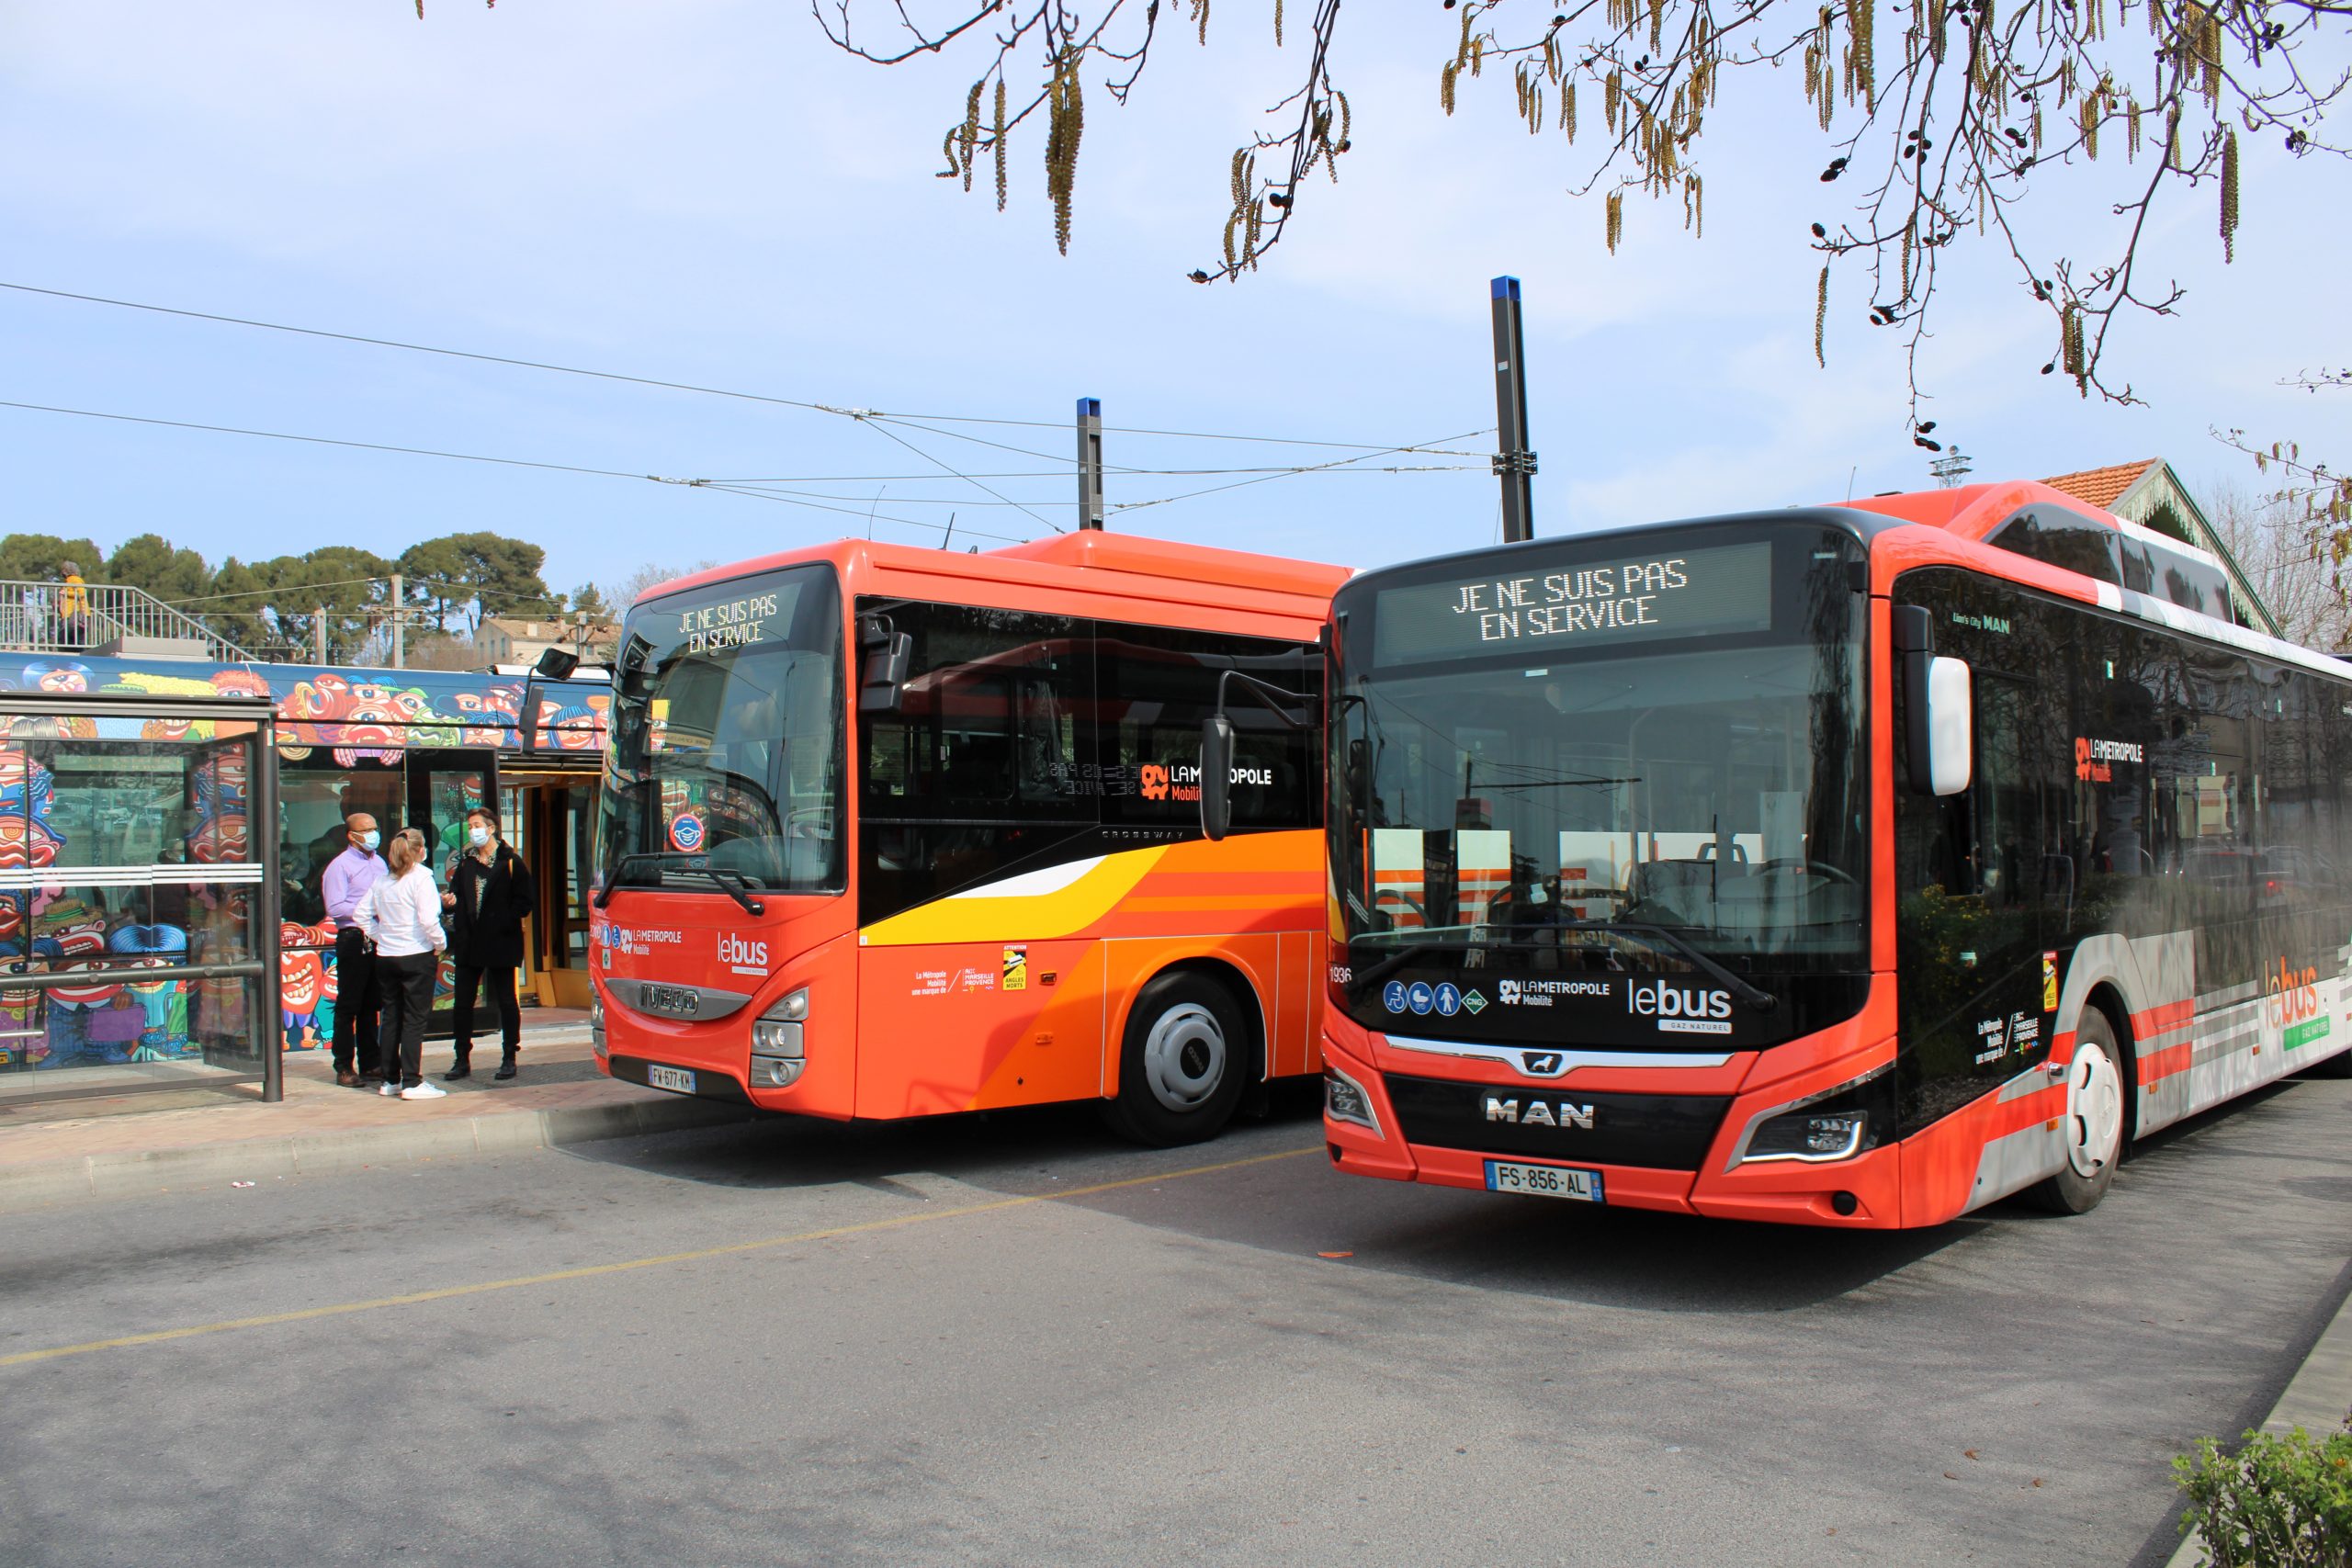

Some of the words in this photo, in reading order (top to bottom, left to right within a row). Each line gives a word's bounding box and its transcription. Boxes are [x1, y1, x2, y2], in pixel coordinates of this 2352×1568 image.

[1453, 584, 1488, 614] JE
[1498, 578, 1535, 608] NE
[1544, 568, 1614, 602] SUIS
[1623, 558, 1687, 593] PAS
[679, 612, 695, 633] JE
[697, 607, 715, 629] NE
[718, 600, 747, 626] SUIS
[750, 594, 777, 619] PAS
[1481, 610, 1519, 641] EN
[1528, 595, 1657, 636] SERVICE
[1983, 615, 2010, 634] MAN
[689, 631, 707, 653] EN
[708, 620, 763, 649] SERVICE
[718, 931, 768, 965] lebus
[1329, 966, 1352, 984] 1936
[640, 984, 699, 1014] IVECO
[1465, 998, 1483, 1007] CNG
[1522, 994, 1554, 1007] Mobilité
[1628, 978, 1732, 1019] lebus
[2265, 955, 2318, 1030] lebus
[1690, 1023, 1729, 1032] NATUREL
[1487, 1098, 1594, 1128] MAN
[1498, 1166, 1587, 1194] FS-856-AL
